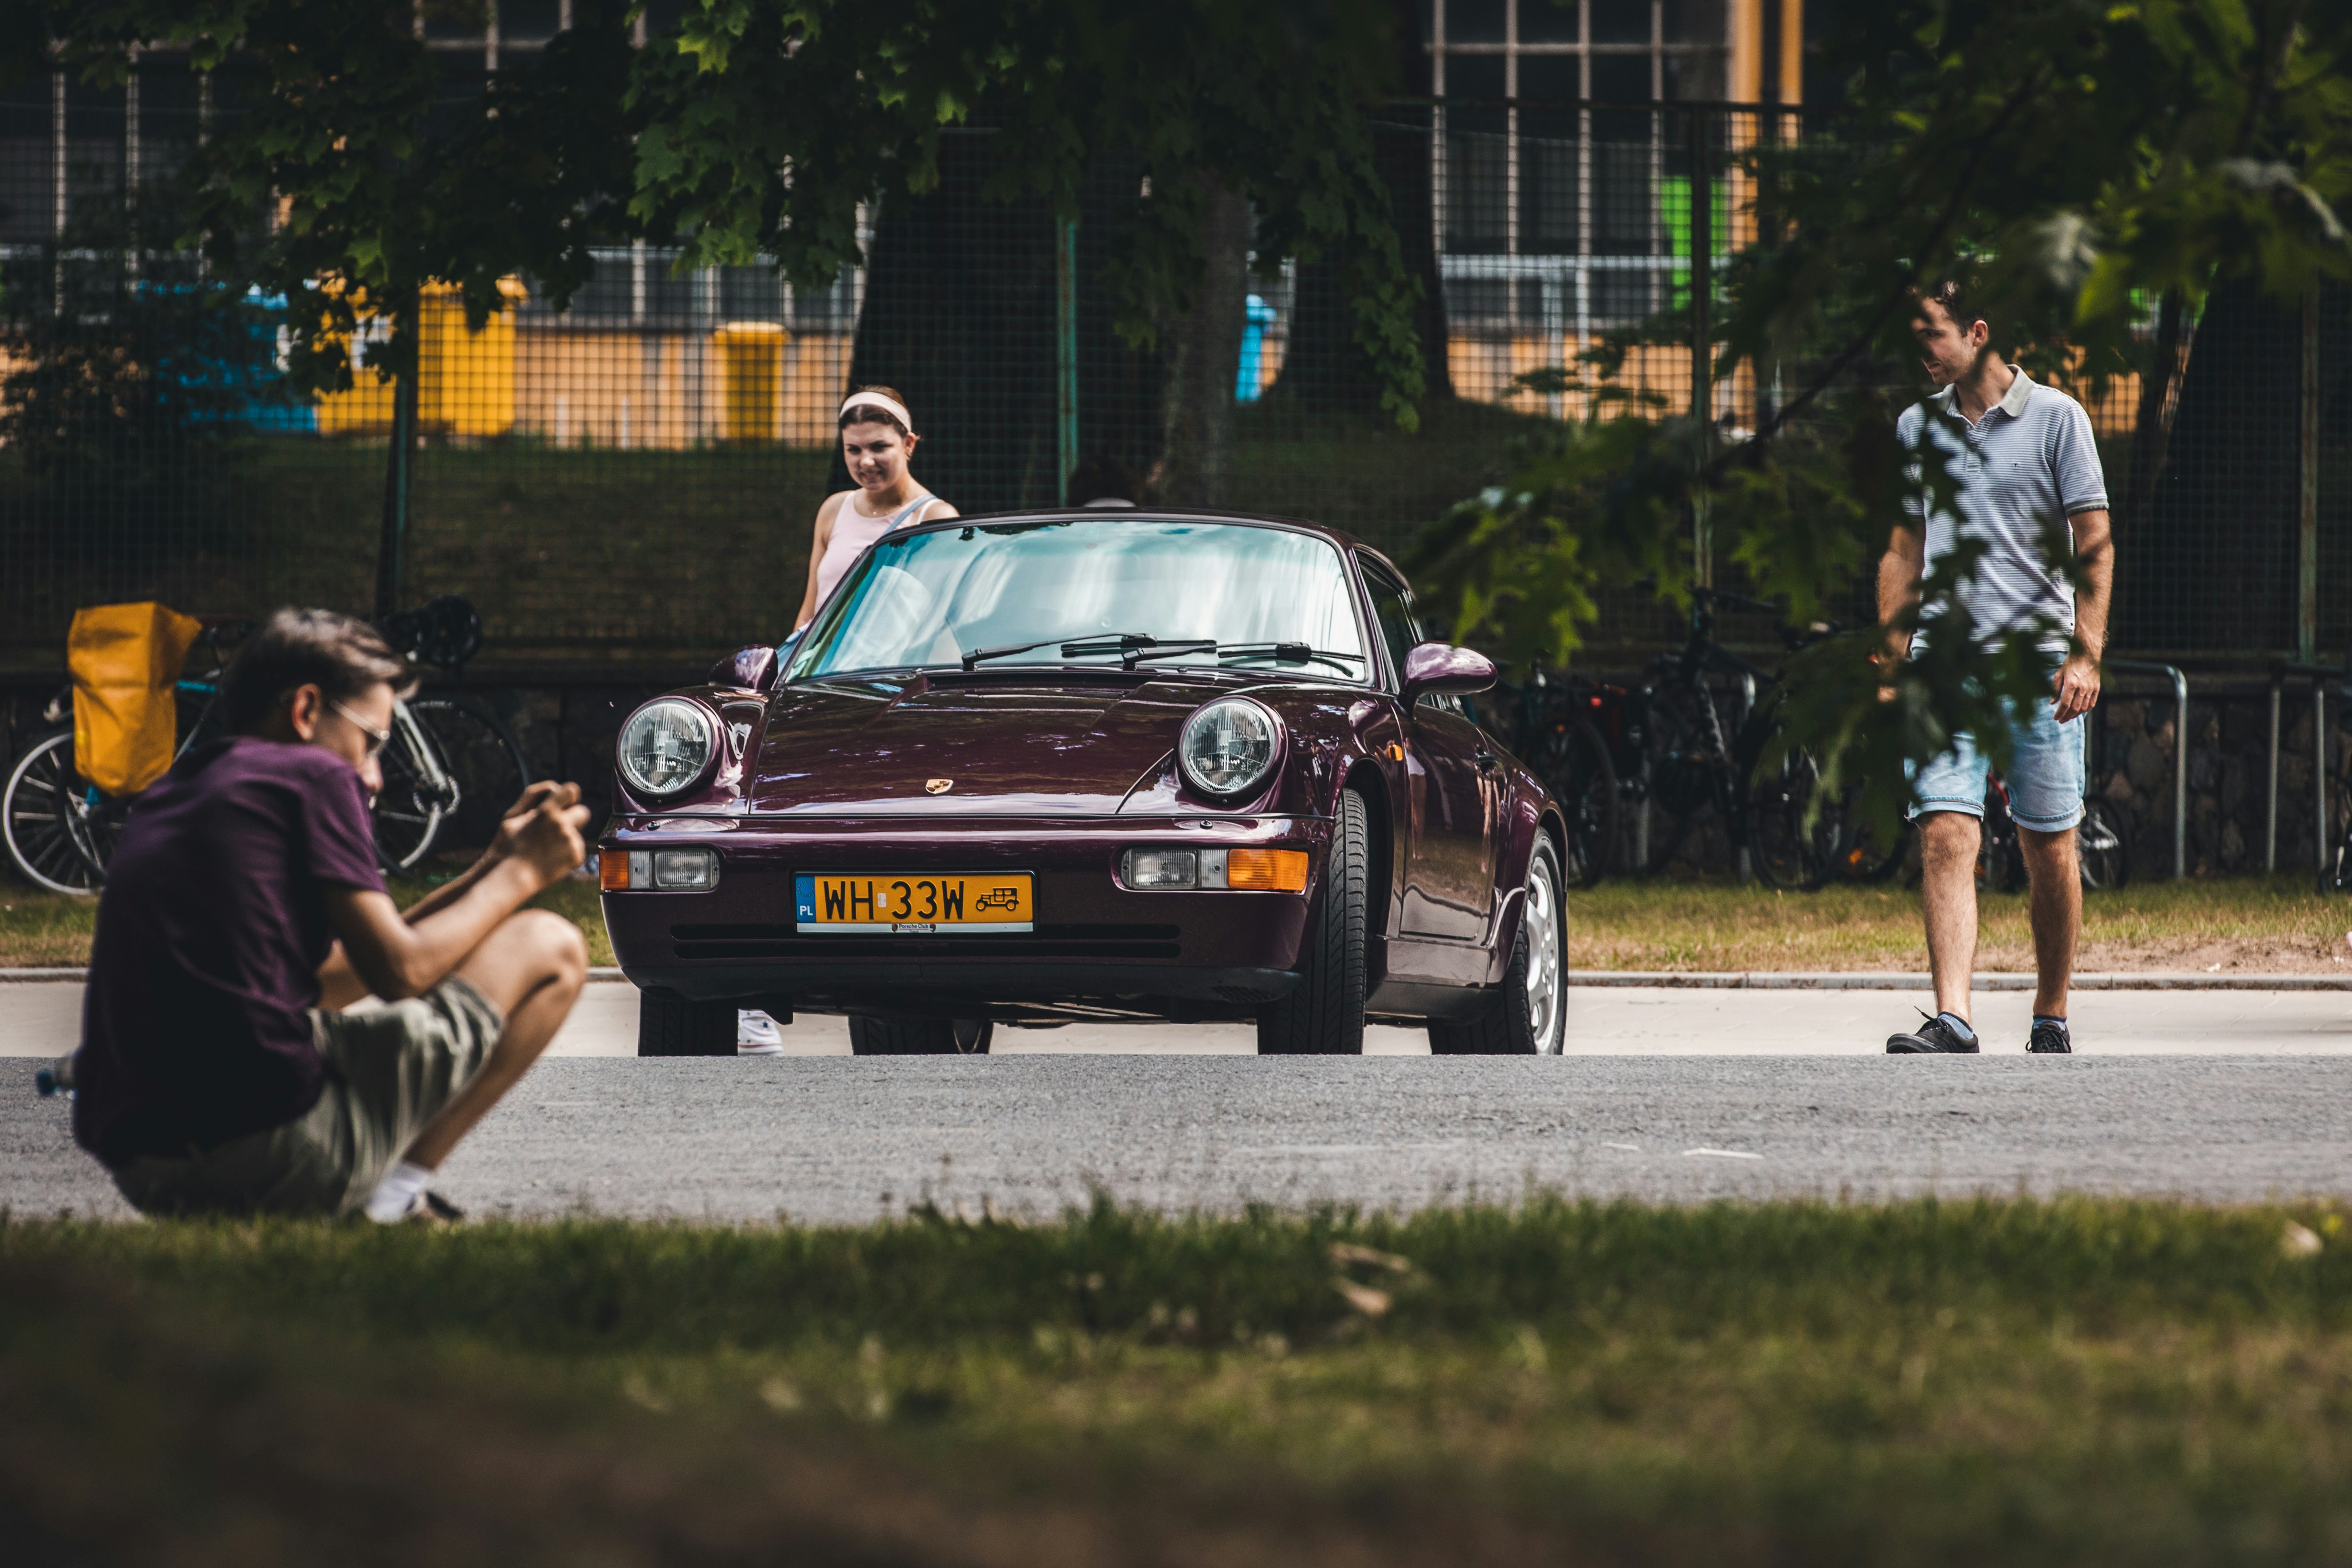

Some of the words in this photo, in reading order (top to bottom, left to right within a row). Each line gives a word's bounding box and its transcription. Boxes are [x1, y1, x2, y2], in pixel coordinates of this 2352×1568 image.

[799, 905, 813, 915] PL
[824, 881, 874, 919] WH
[891, 880, 964, 919] 33W
